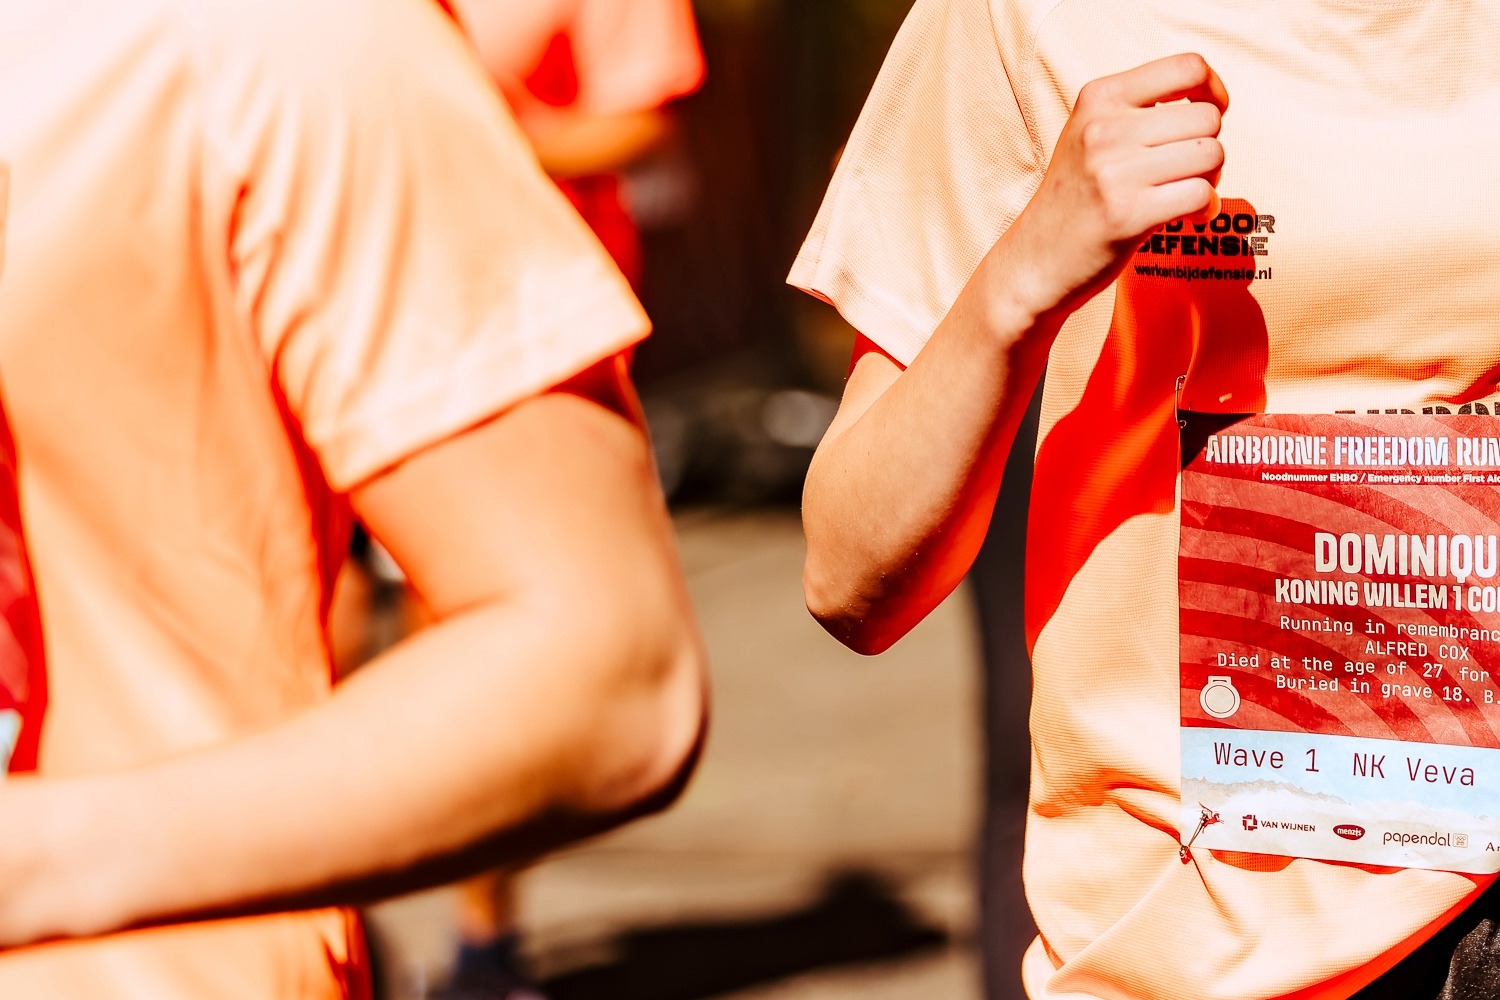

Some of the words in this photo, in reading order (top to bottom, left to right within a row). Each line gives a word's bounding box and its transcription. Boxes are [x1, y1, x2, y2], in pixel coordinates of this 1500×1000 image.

[1134, 265, 1272, 282] werkenbijdefensie.nl
[1205, 434, 1327, 465] AIRBORNE
[1334, 436, 1449, 466] FREEDOM
[1261, 471, 1327, 482] Noodnummer
[1330, 473, 1358, 483] EHBO
[1367, 473, 1422, 485] Emergency
[1424, 474, 1461, 483] number
[1463, 474, 1485, 484] First
[1275, 578, 1359, 606] KONING
[1363, 582, 1448, 610] WILLEM
[1452, 585, 1462, 611] 1
[1280, 615, 1353, 635] Running
[1365, 619, 1385, 634] in
[1365, 640, 1428, 657] ALFRED
[1439, 644, 1470, 661] COX
[1217, 653, 1259, 668] Died
[1270, 656, 1291, 669] at
[1302, 656, 1333, 671] the
[1344, 661, 1375, 676] age
[1386, 661, 1407, 675] of
[1422, 662, 1443, 679] 27
[1459, 666, 1490, 682] for
[1276, 674, 1339, 692] Buried
[1350, 677, 1370, 694] in
[1381, 682, 1433, 699] grave
[1442, 685, 1471, 702] 18.
[1213, 741, 1284, 769] Wave
[1304, 748, 1320, 773] 1
[1353, 752, 1386, 779] NK
[1406, 757, 1475, 786] Veva
[1260, 820, 1279, 829] VAN
[1280, 822, 1316, 832] WIJNEN
[1337, 827, 1362, 837] menzis
[1383, 831, 1451, 847] papendal
